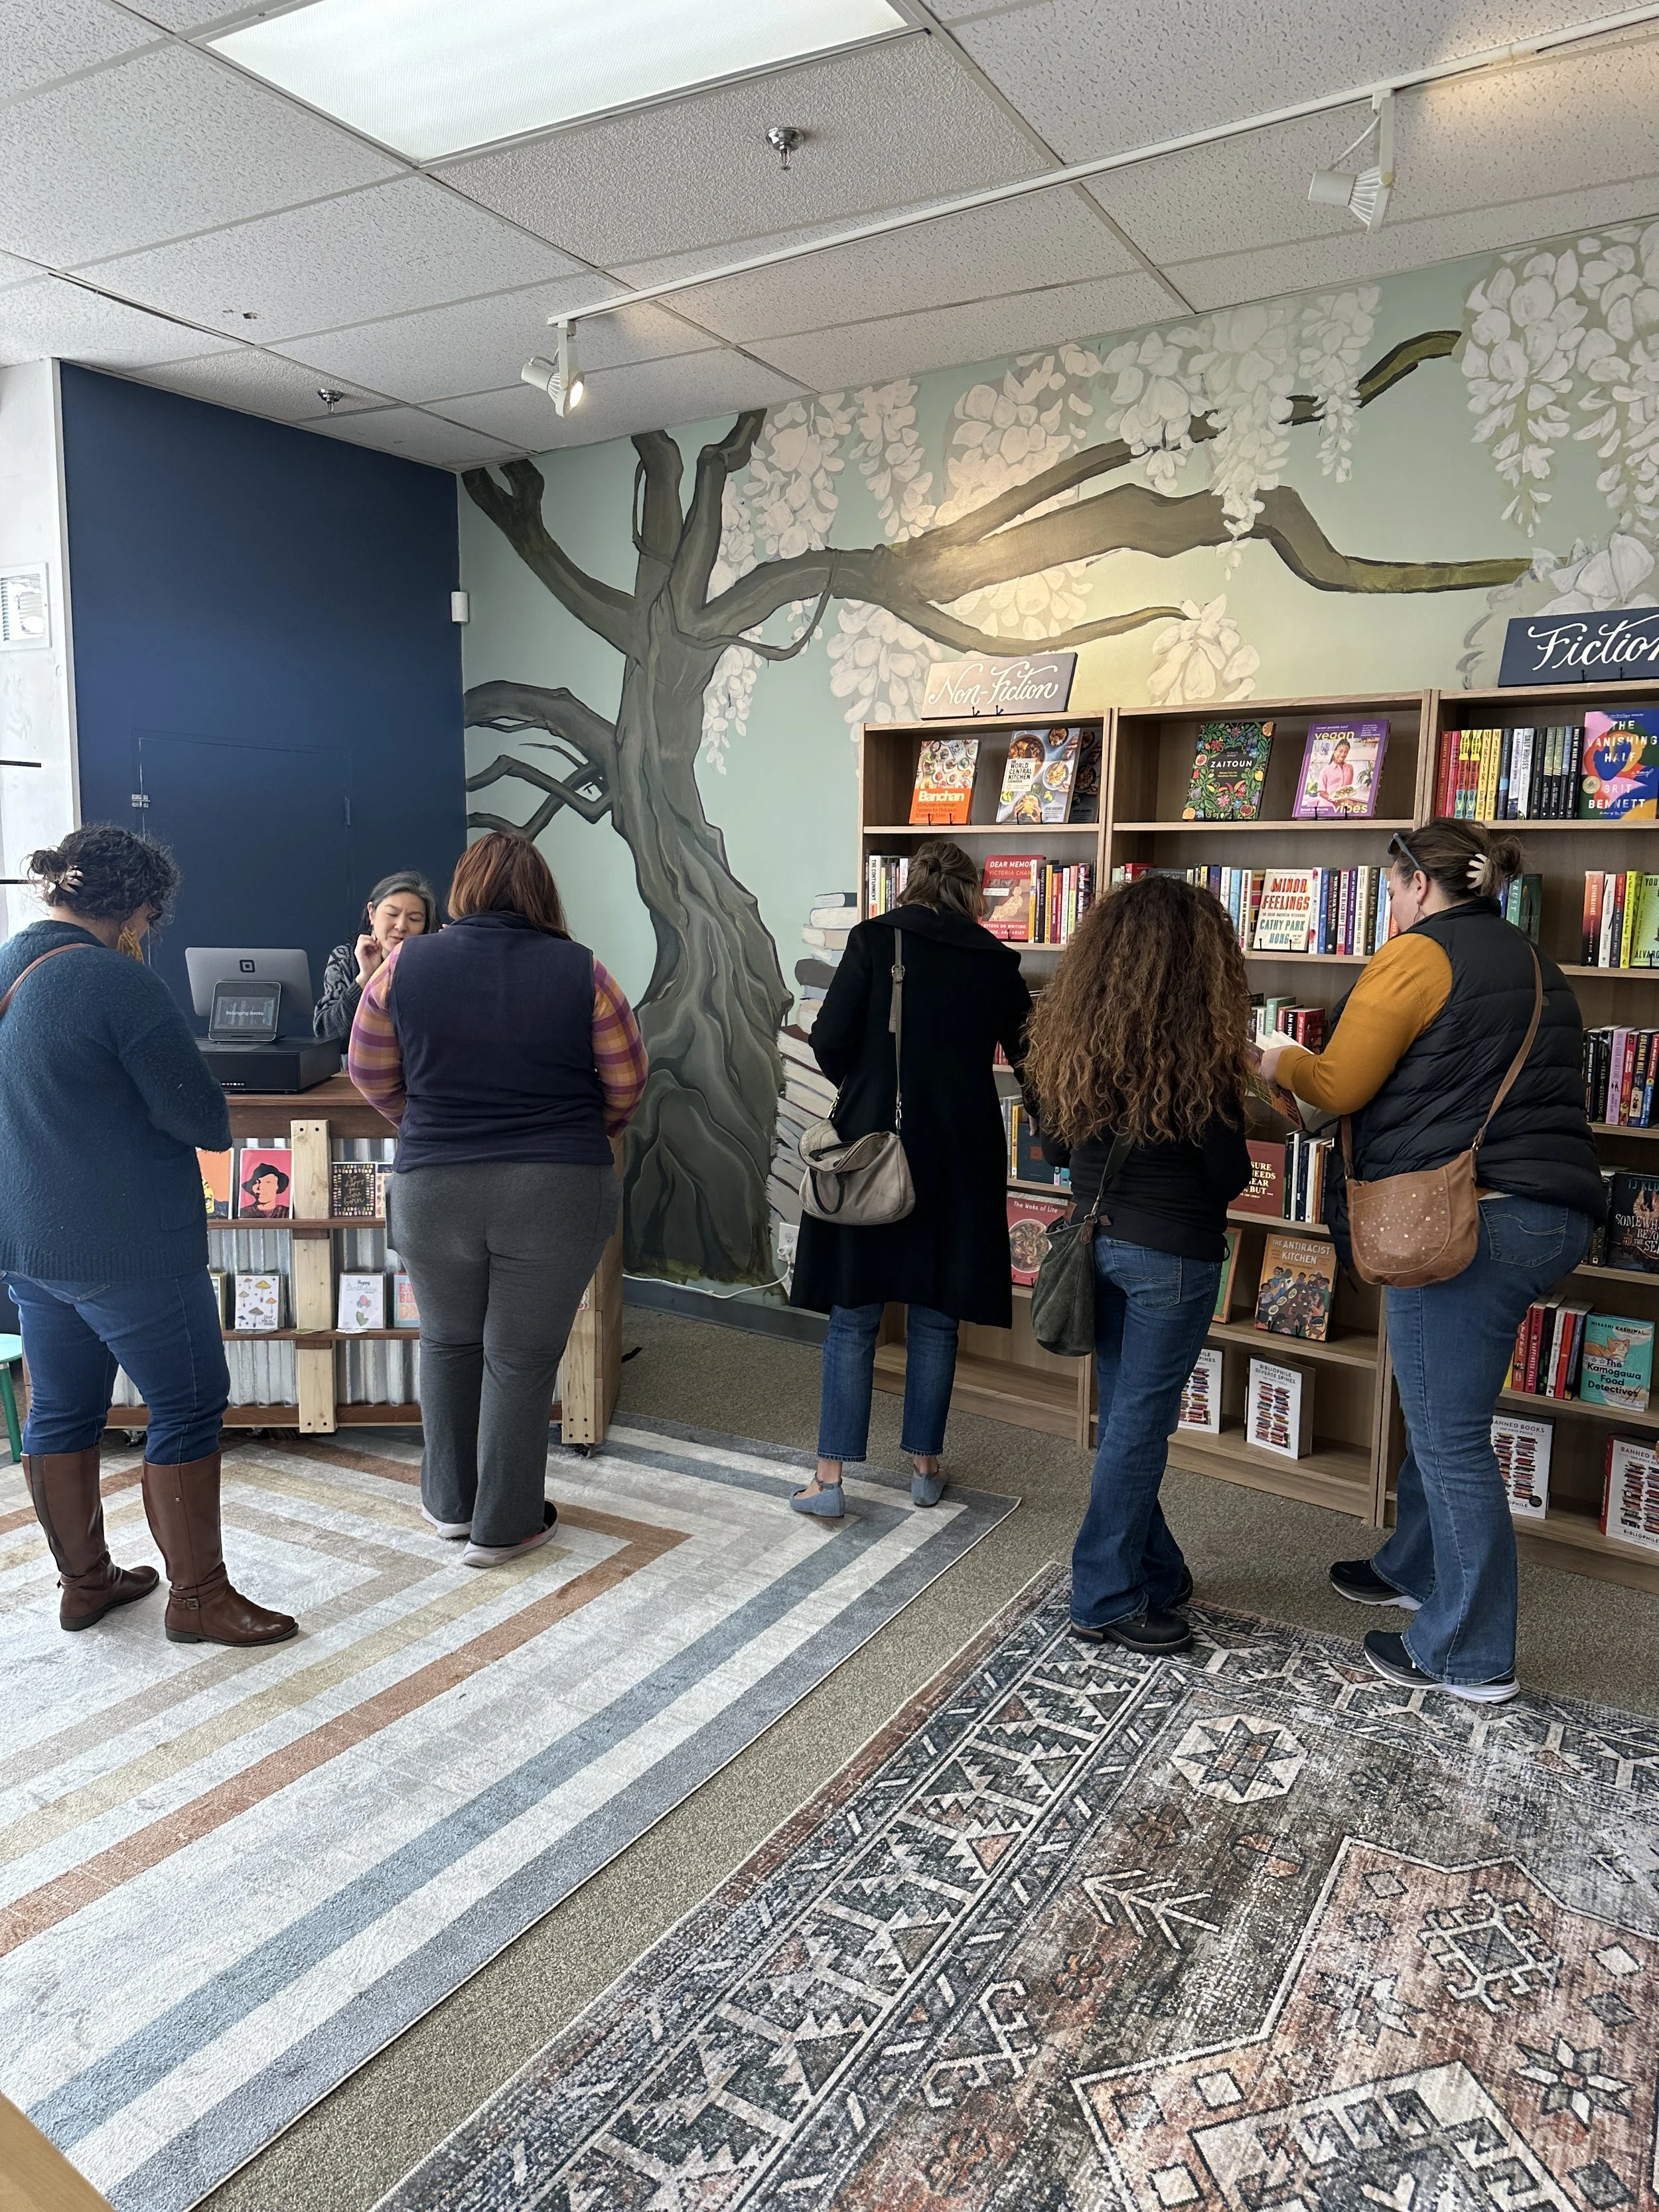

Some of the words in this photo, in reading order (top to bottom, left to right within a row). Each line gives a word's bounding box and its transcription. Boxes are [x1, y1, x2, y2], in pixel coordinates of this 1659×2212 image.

[928, 661, 1059, 705] Non-Fiction
[1612, 721, 1635, 730] THE
[1315, 731, 1354, 740] vegan
[1587, 735, 1657, 747] VANISHING
[1605, 753, 1636, 762] HALF
[1604, 784, 1632, 793] BRIT
[918, 790, 964, 802] Banchan
[1333, 802, 1367, 813] vibes
[1588, 799, 1646, 808] BENNETT
[1271, 878, 1307, 893] MINOR
[1510, 879, 1519, 912] TRUST
[1262, 895, 1310, 911] FEELINGS
[1260, 919, 1283, 930] CATHY
[1285, 920, 1305, 931] PARK
[1269, 933, 1289, 944] HONG
[1288, 1013, 1293, 1022] AN
[1638, 1035, 1647, 1061] COLEMAN
[1636, 1062, 1644, 1074] HILL
[1251, 1161, 1271, 1171] SURE
[1249, 1178, 1269, 1187] EAR
[1628, 1179, 1637, 1189] TJ
[344, 1197, 365, 1207] born
[1025, 1202, 1039, 1211] Woks
[1615, 1214, 1659, 1230] SOMEWH
[1283, 1240, 1331, 1255] ANTIRACIST
[1282, 1251, 1317, 1264] KITCHEN
[1606, 1358, 1623, 1368] The
[1255, 1368, 1276, 1378] DIVERSE
[1277, 1374, 1295, 1384] SPINES
[1260, 1364, 1292, 1377] BIBLIOPHILE
[1587, 1363, 1641, 1380] Kamogawa
[1601, 1374, 1624, 1386] Food
[1588, 1380, 1638, 1397] Detectives
[1520, 1424, 1545, 1433] BOOKS
[1621, 1447, 1650, 1458] BANNED
[1623, 1530, 1659, 1543] BIBLIOPHILE
